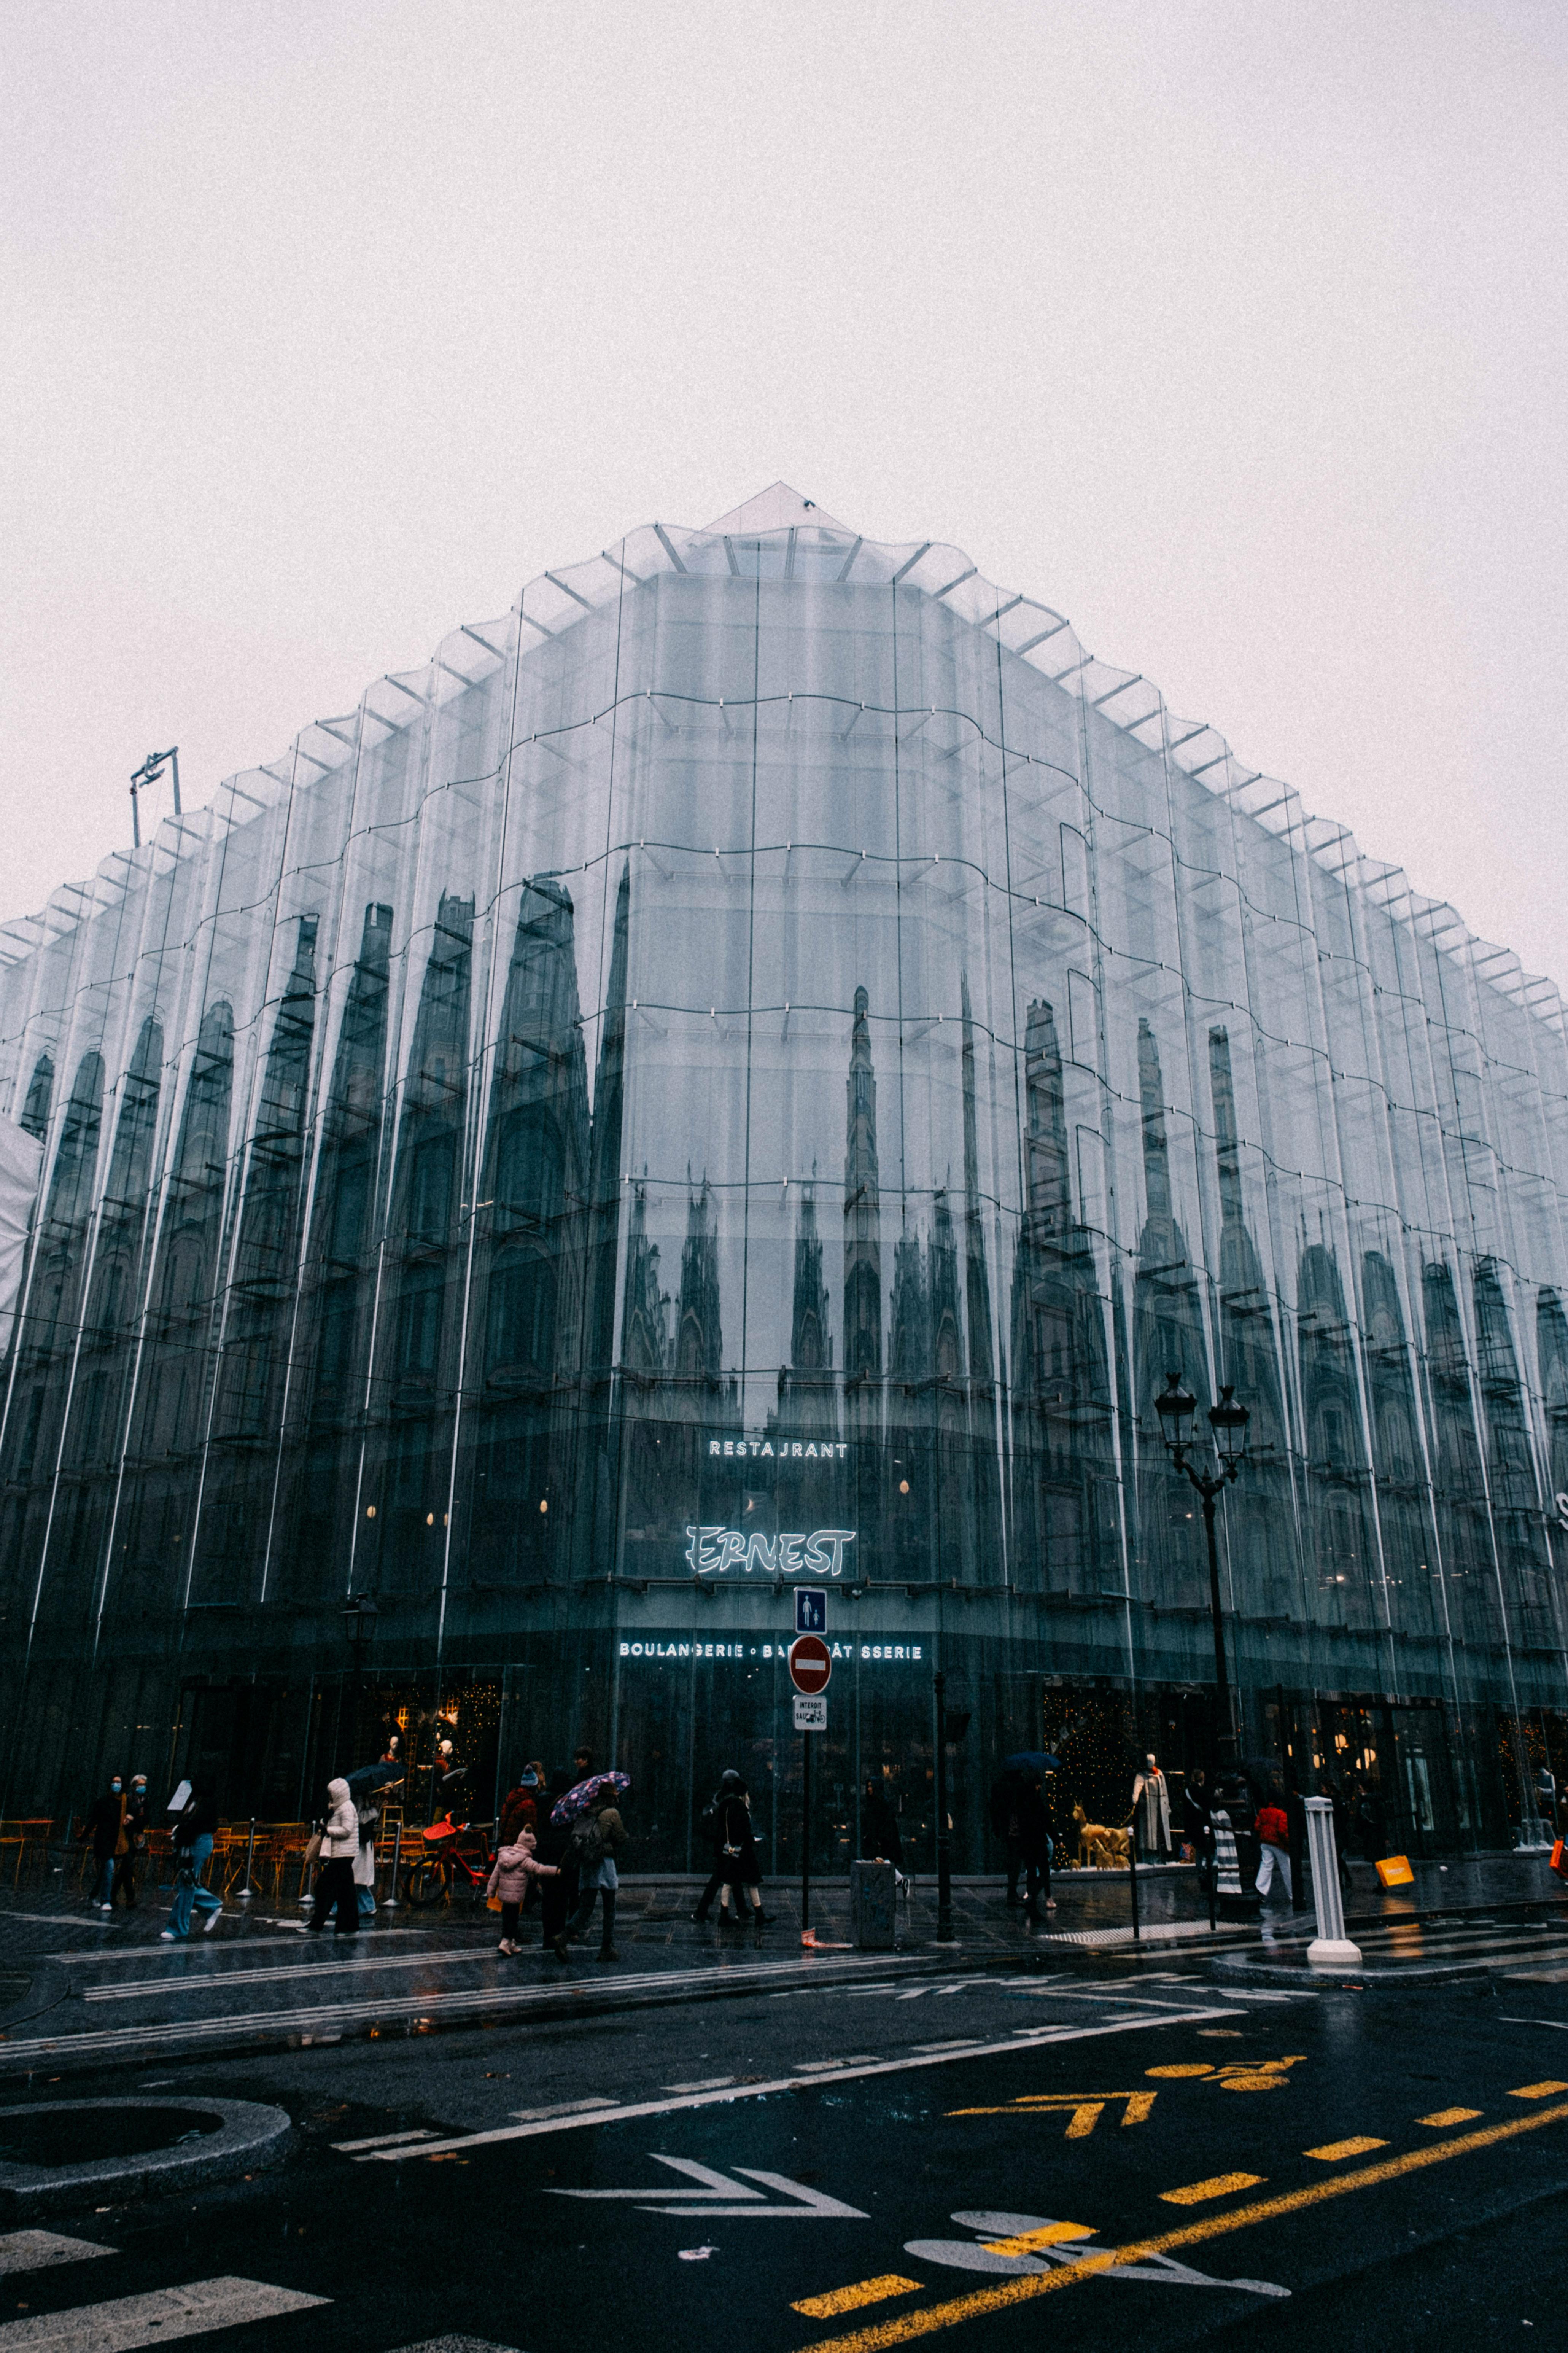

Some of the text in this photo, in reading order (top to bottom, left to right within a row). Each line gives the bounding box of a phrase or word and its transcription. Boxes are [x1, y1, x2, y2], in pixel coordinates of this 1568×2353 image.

[685, 1526, 856, 1576] ERNEST
[620, 1643, 743, 1658] BOULANGERIE
[827, 1642, 922, 1659] ÂTSSERIE
